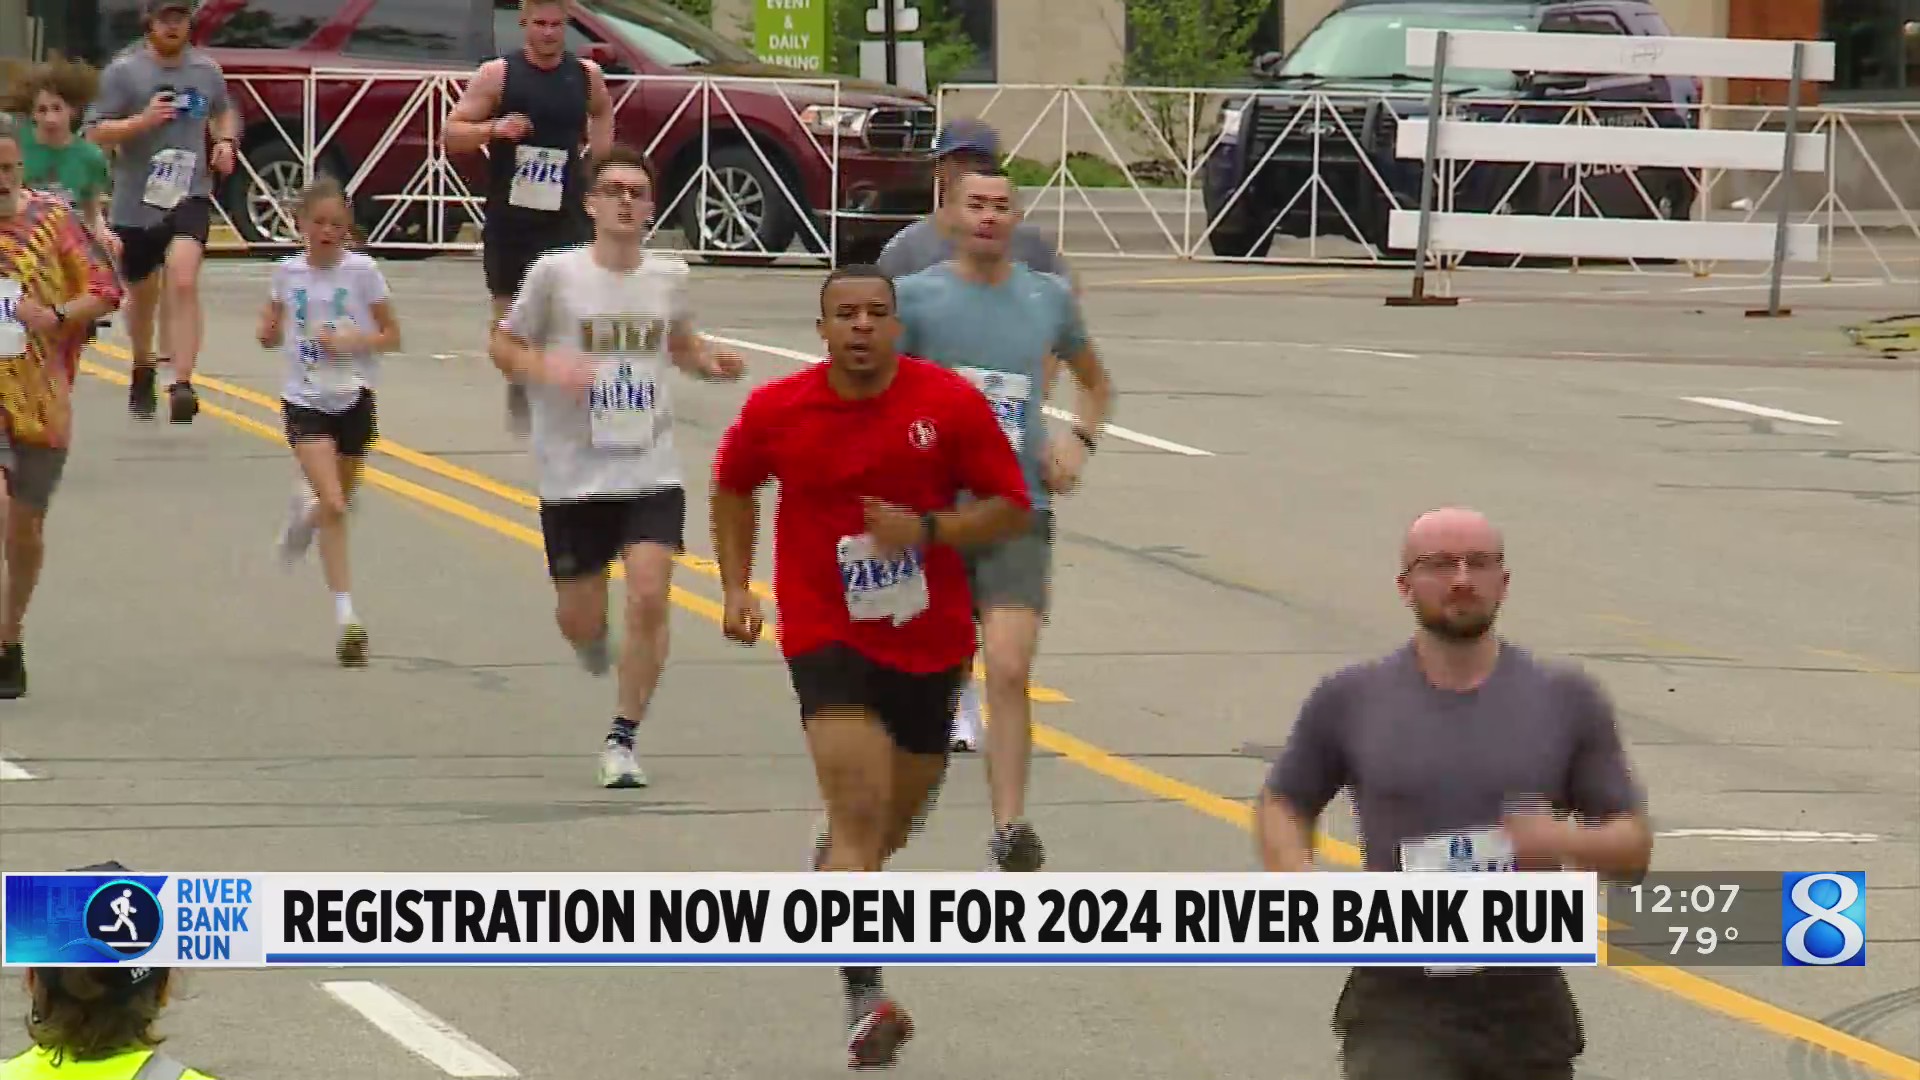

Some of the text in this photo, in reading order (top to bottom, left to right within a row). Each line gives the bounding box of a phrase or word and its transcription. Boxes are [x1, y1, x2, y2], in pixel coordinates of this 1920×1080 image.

[767, 0, 811, 9] EVENT
[784, 16, 793, 29] &
[769, 34, 810, 50] DAILY
[1563, 163, 1639, 180] POLI
